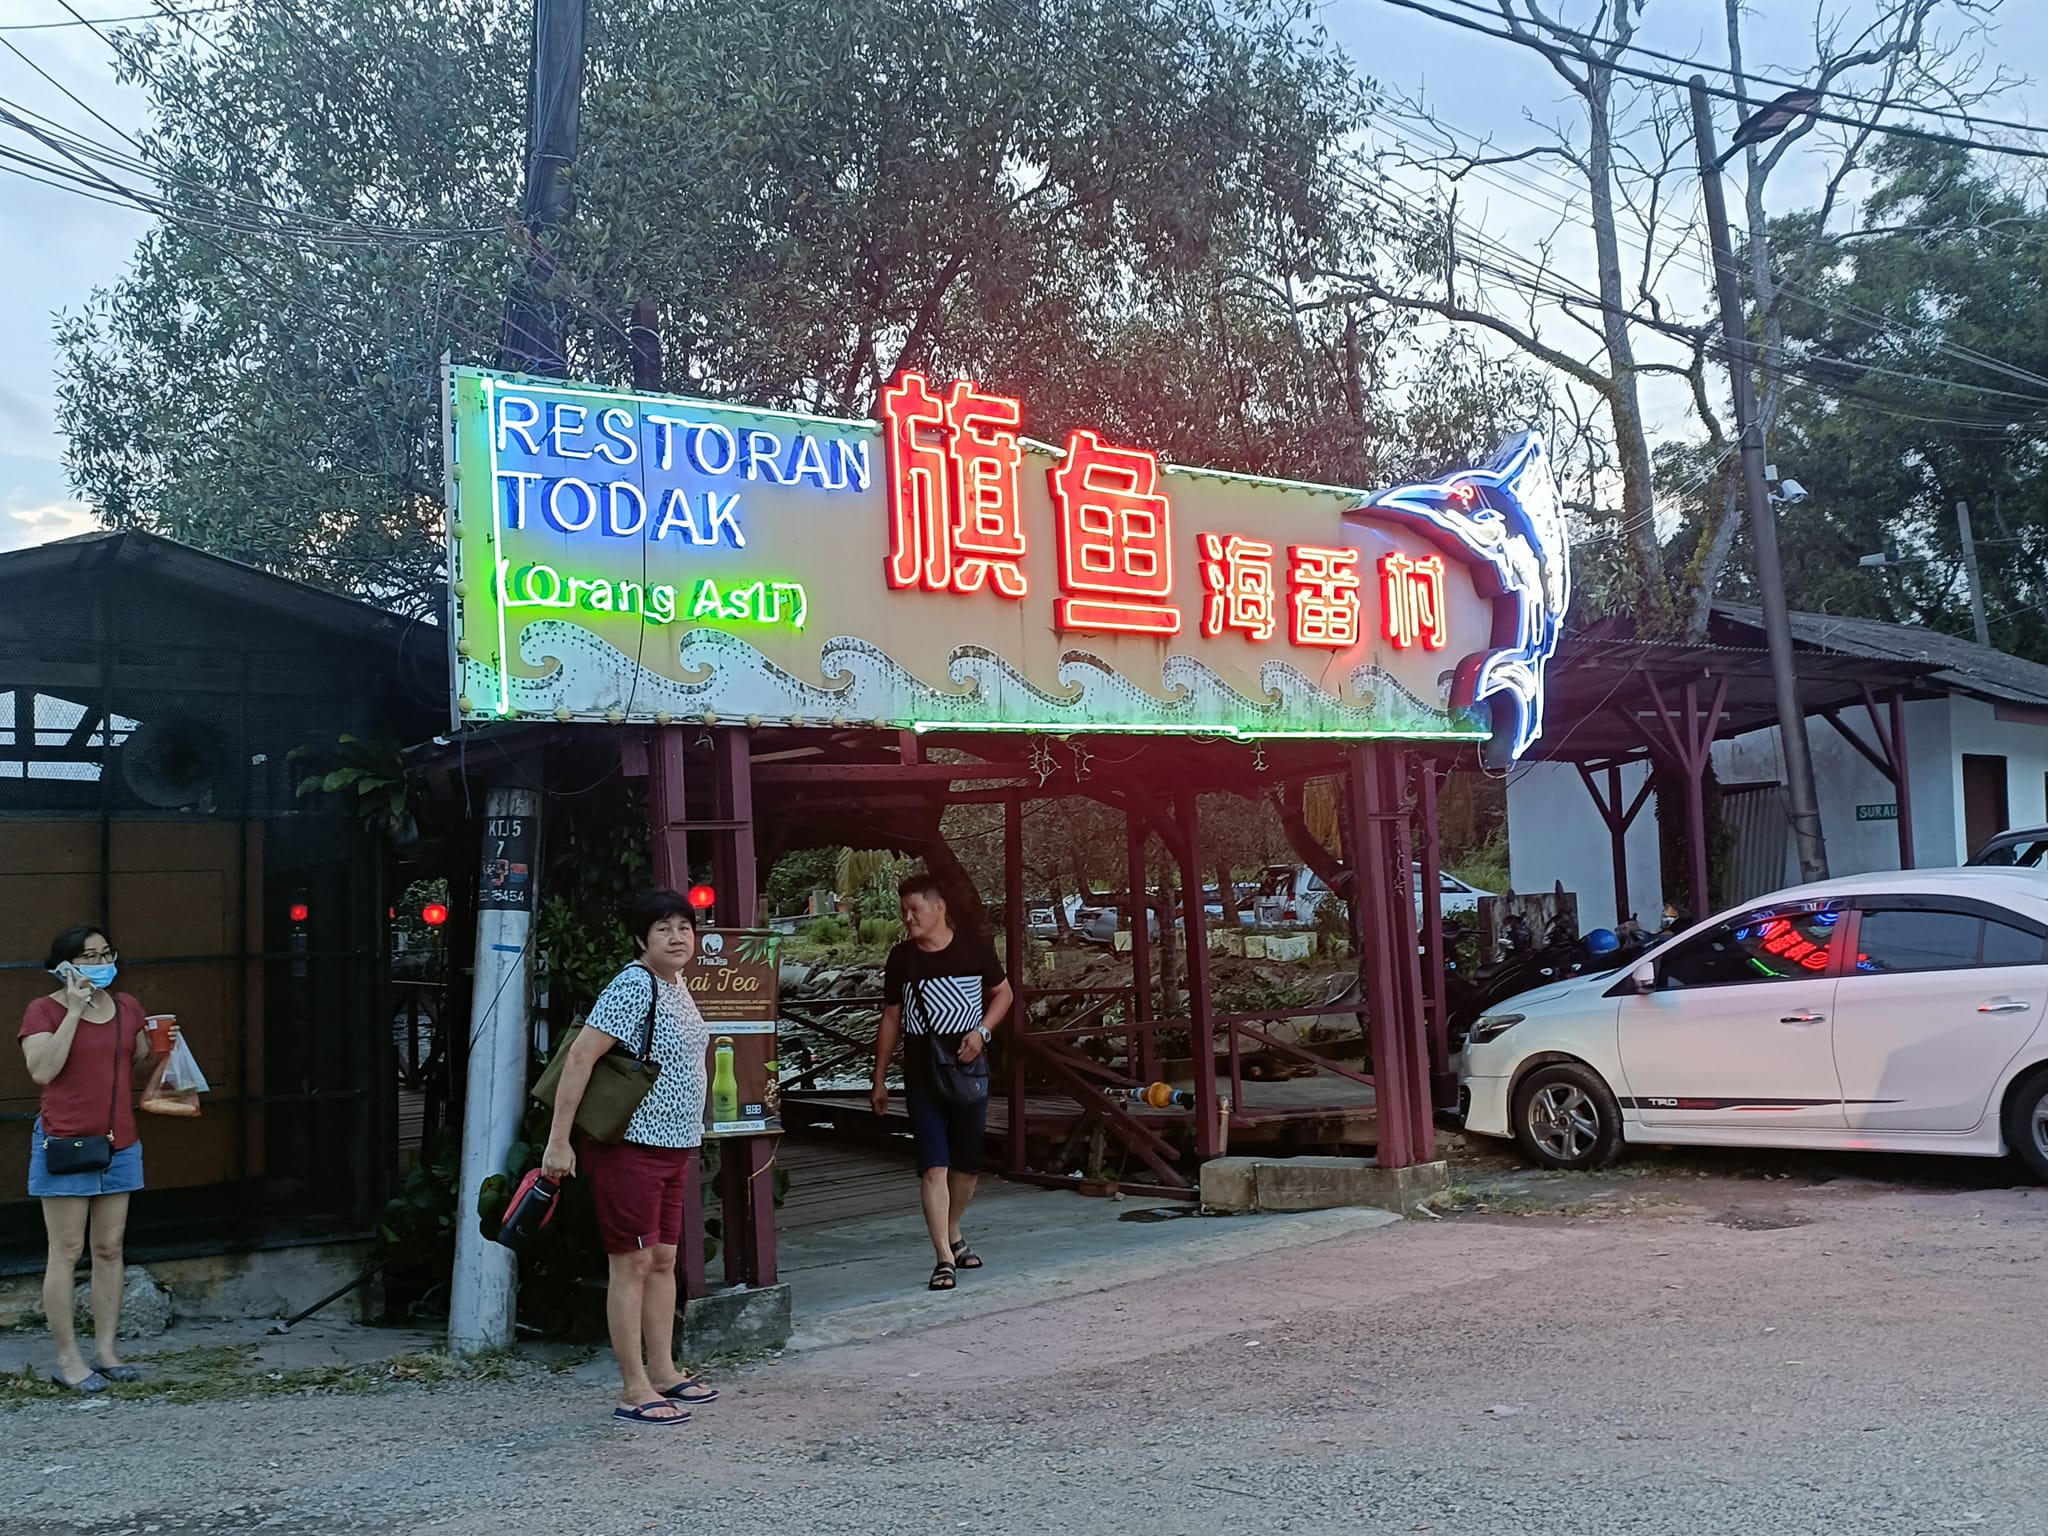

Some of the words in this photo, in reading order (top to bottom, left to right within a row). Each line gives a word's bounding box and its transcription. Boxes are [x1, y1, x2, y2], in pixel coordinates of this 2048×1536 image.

[496, 395, 872, 492] RESTORAN
[495, 470, 747, 549] TODAK
[882, 370, 1448, 653] 旗鱼海番村
[1859, 805, 1898, 818] SURAU
[511, 819, 522, 838] 5
[716, 967, 760, 992] Tea
[1647, 1098, 1678, 1106] TRD
